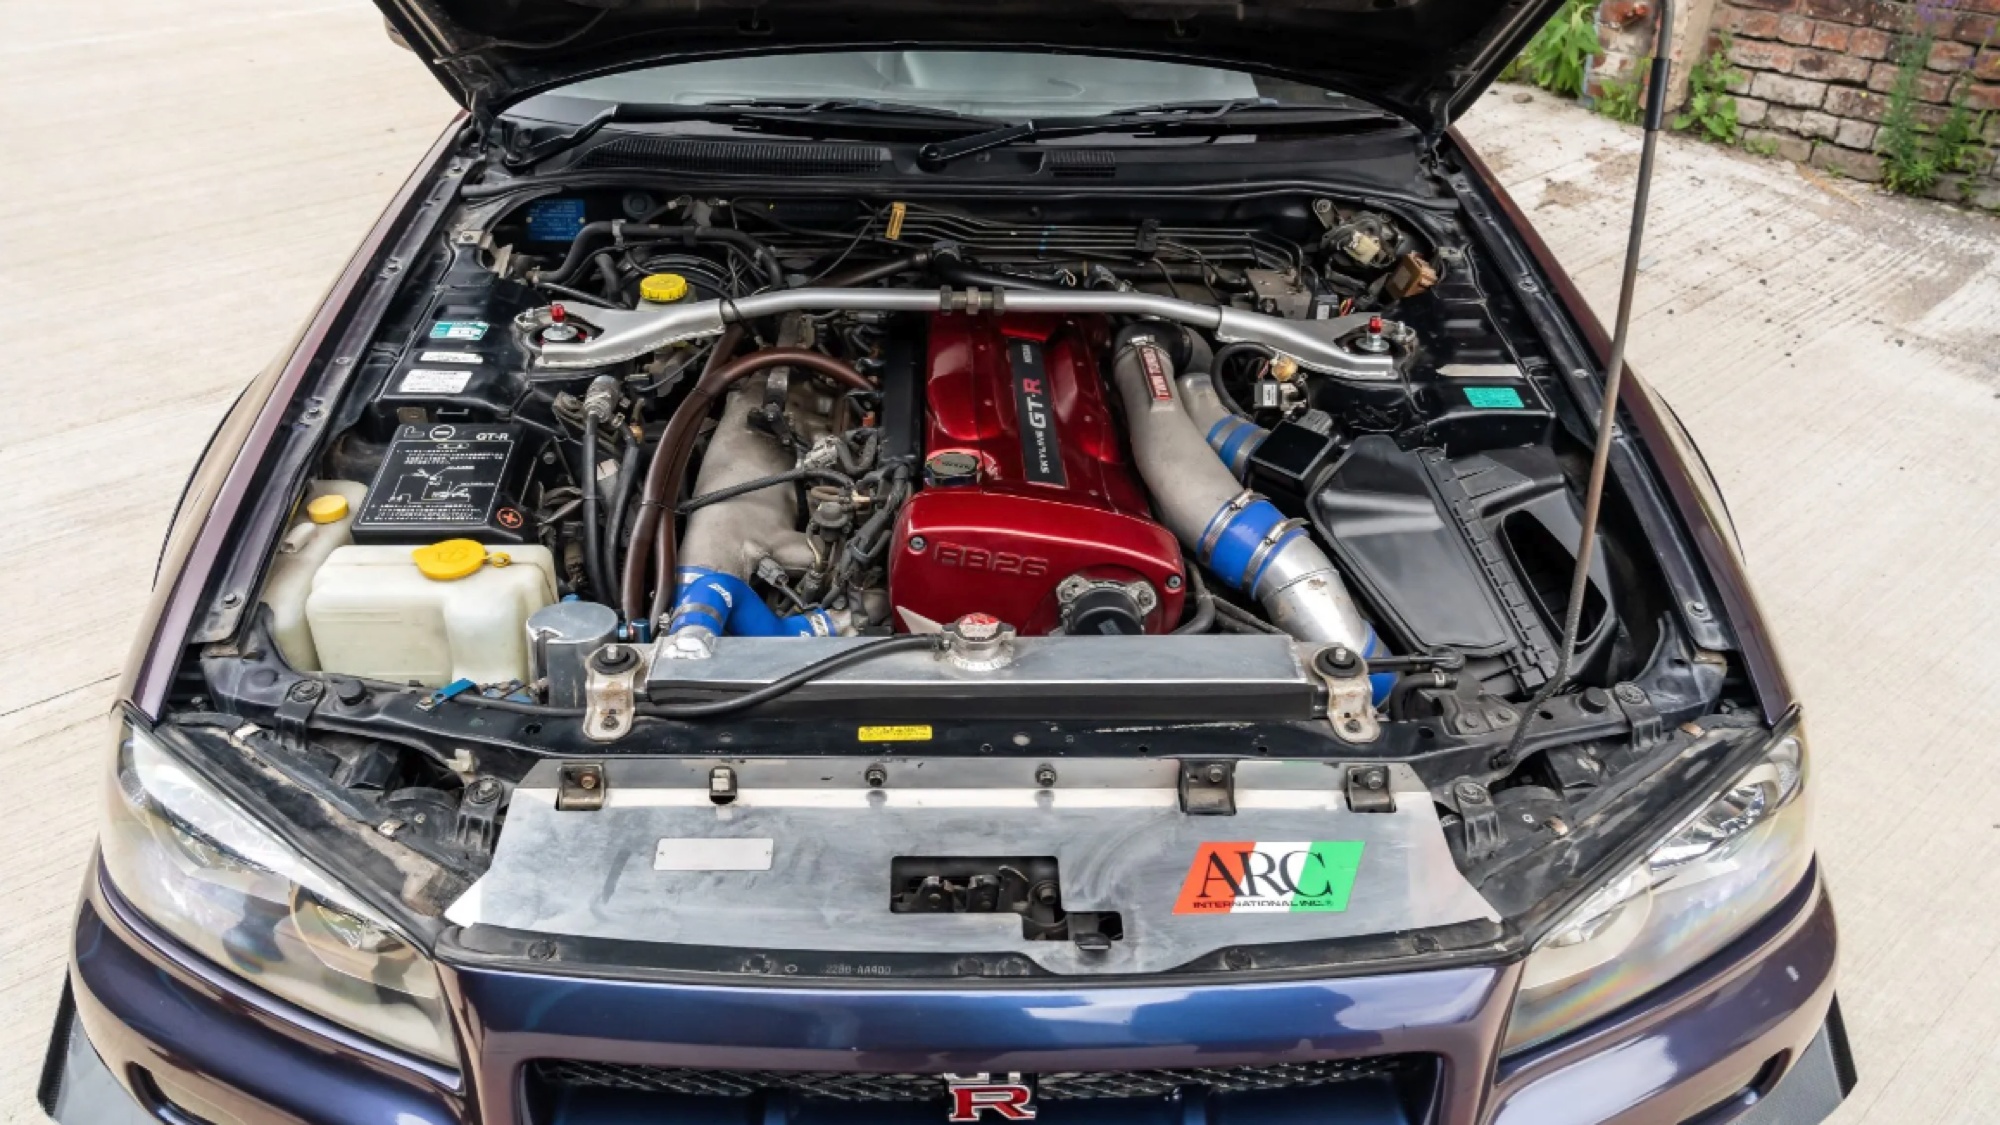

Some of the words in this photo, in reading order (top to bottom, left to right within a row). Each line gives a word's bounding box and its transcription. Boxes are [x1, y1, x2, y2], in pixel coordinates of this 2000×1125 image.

[1023, 377, 1047, 429] GT-R
[476, 432, 509, 441] GT-R
[1035, 430, 1050, 474] SKYLINE
[933, 540, 1050, 578] RB26
[1196, 849, 1333, 898] ARC
[1193, 900, 1298, 909] INTERNATIONAL
